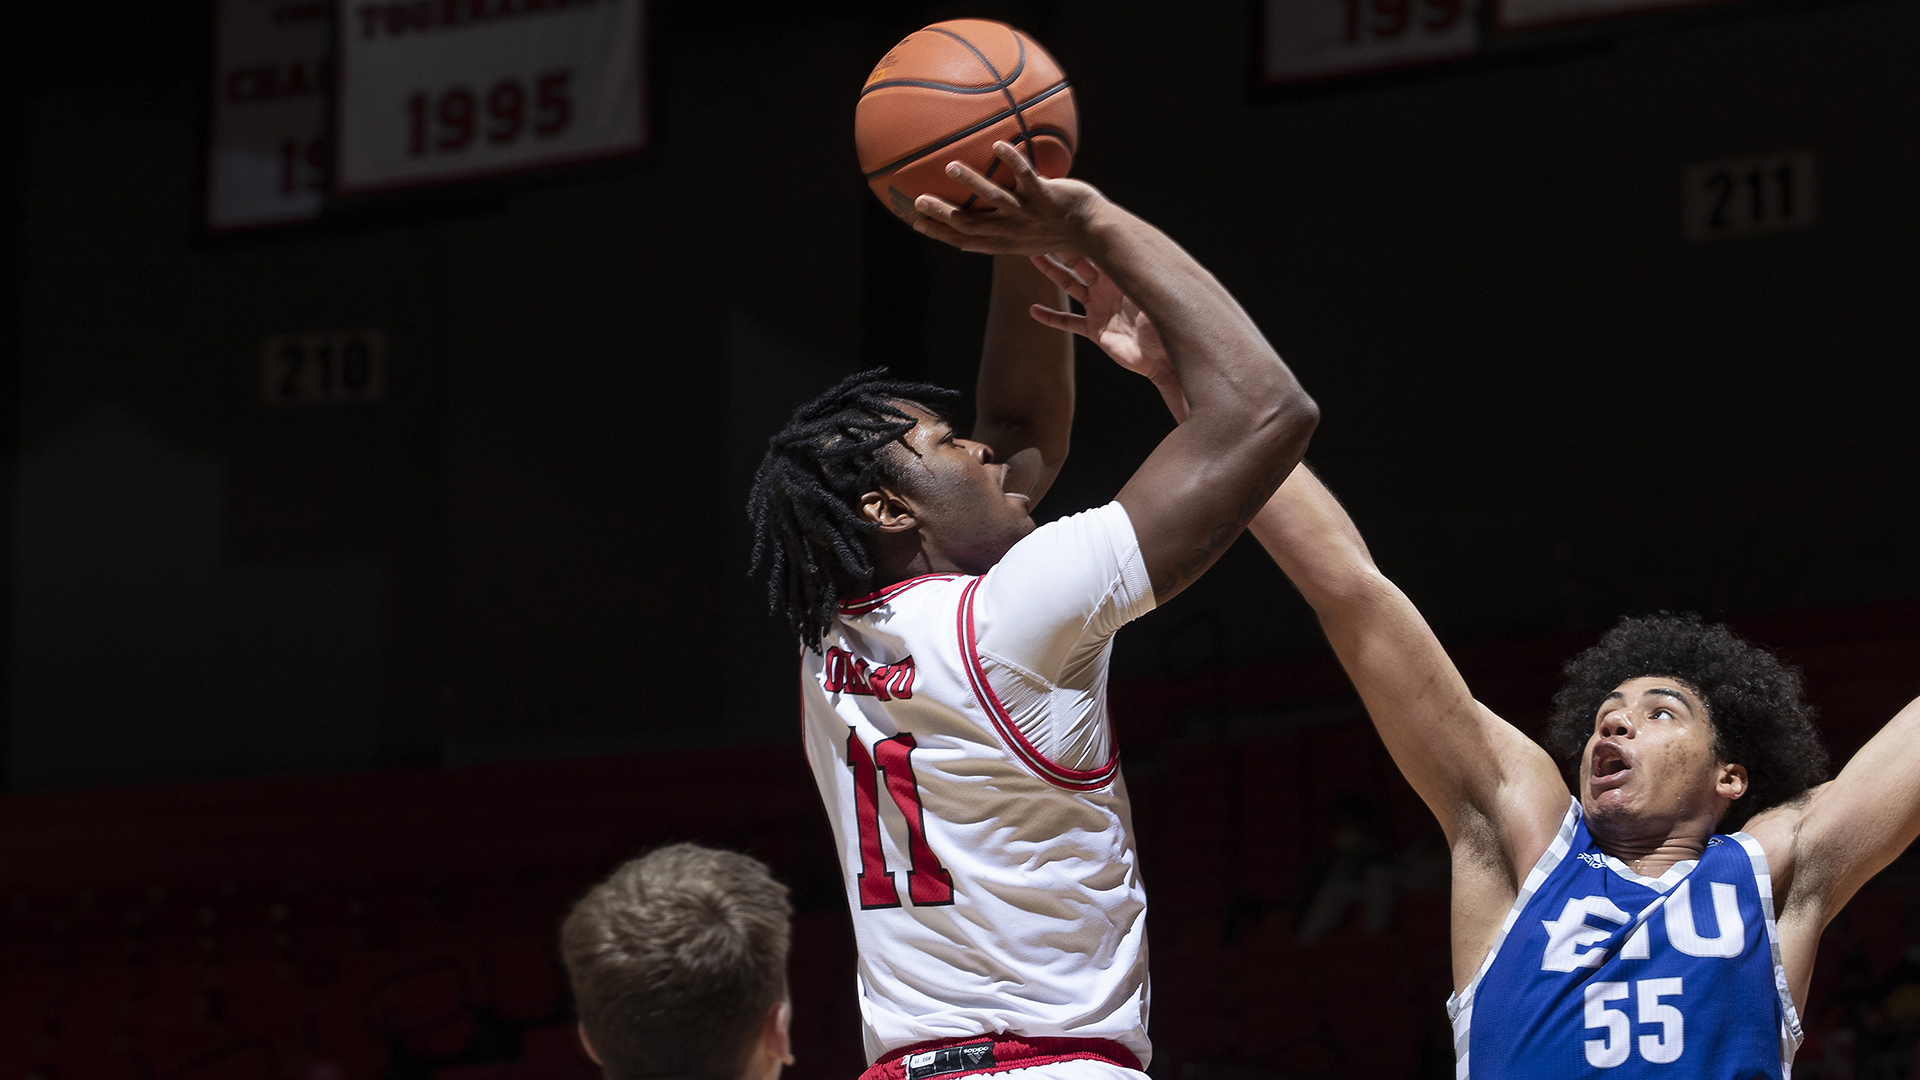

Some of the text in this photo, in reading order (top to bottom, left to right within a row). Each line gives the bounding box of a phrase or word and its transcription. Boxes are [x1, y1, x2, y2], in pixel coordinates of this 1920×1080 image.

[408, 70, 575, 157] 1995
[1707, 166, 1791, 227] 211
[279, 340, 369, 395] 210
[847, 726, 955, 910] 11
[1540, 878, 1745, 973] EIU
[1584, 977, 1684, 1069] 55
